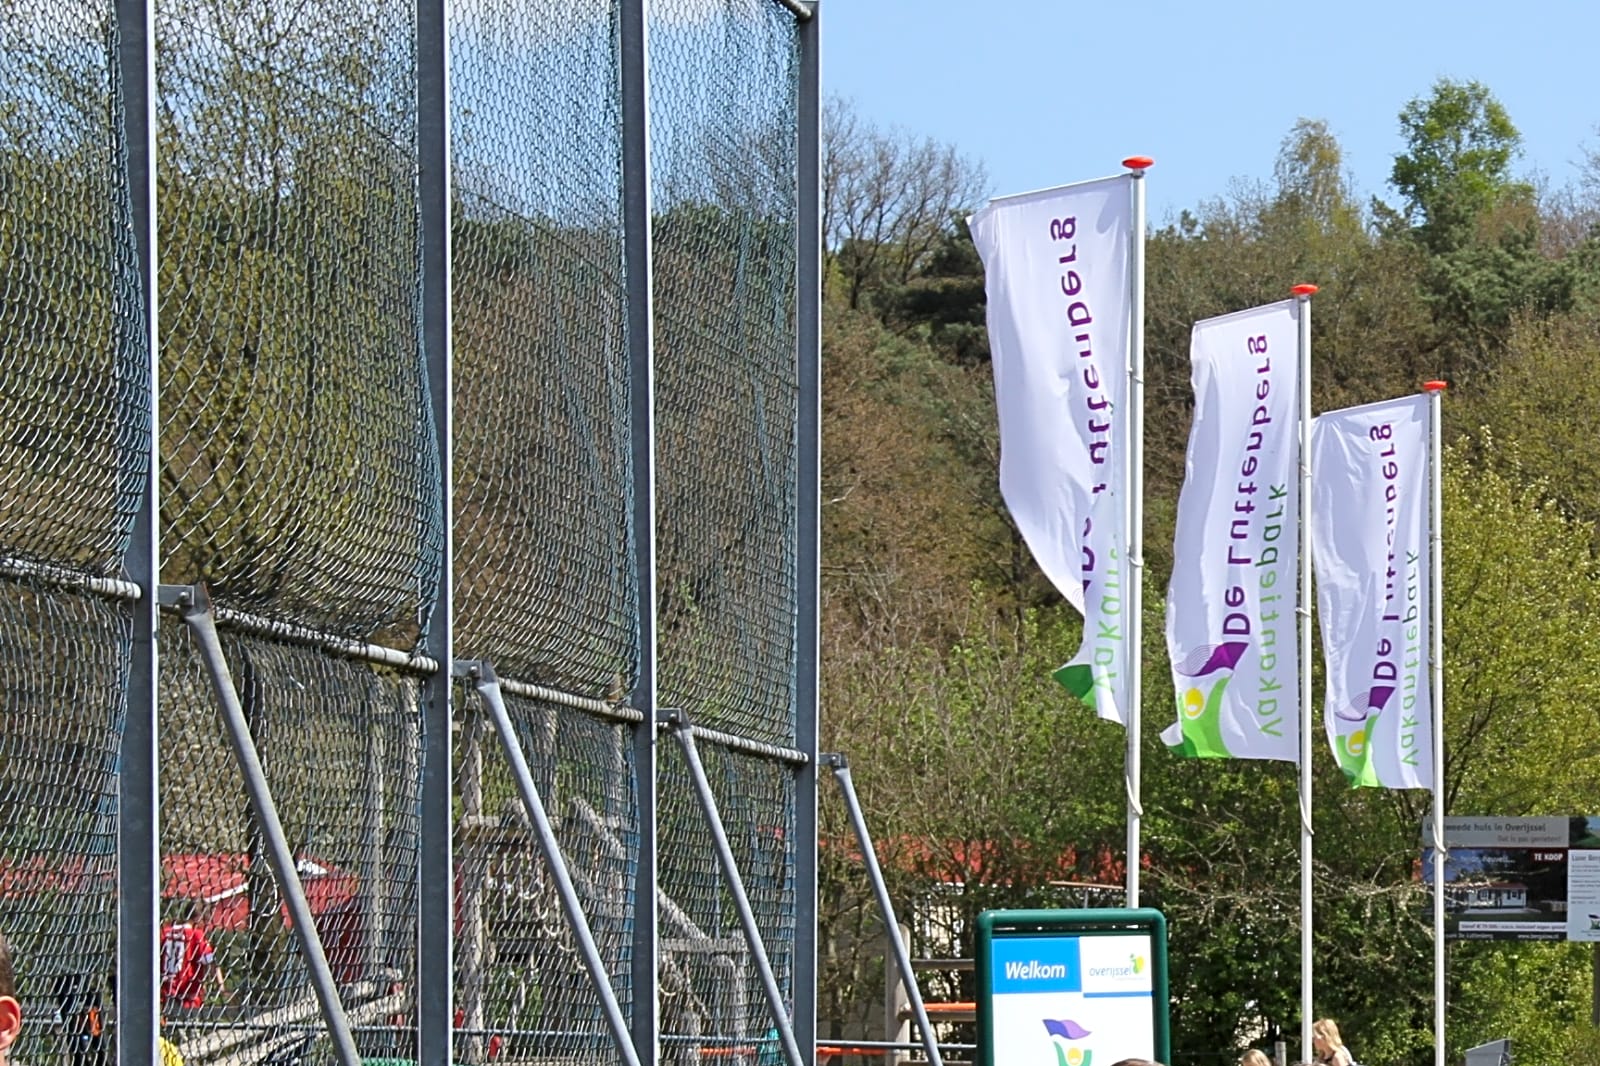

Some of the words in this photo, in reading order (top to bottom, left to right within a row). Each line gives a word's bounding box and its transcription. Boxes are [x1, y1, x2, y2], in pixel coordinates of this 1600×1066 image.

[1443, 823, 1471, 832] weede
[1474, 823, 1492, 831] huis
[1505, 823, 1546, 833] Overijssel
[1534, 853, 1542, 861] TE
[1544, 853, 1563, 861] KOOP
[1005, 961, 1066, 980] Welkom
[1089, 964, 1132, 978] overijssel
